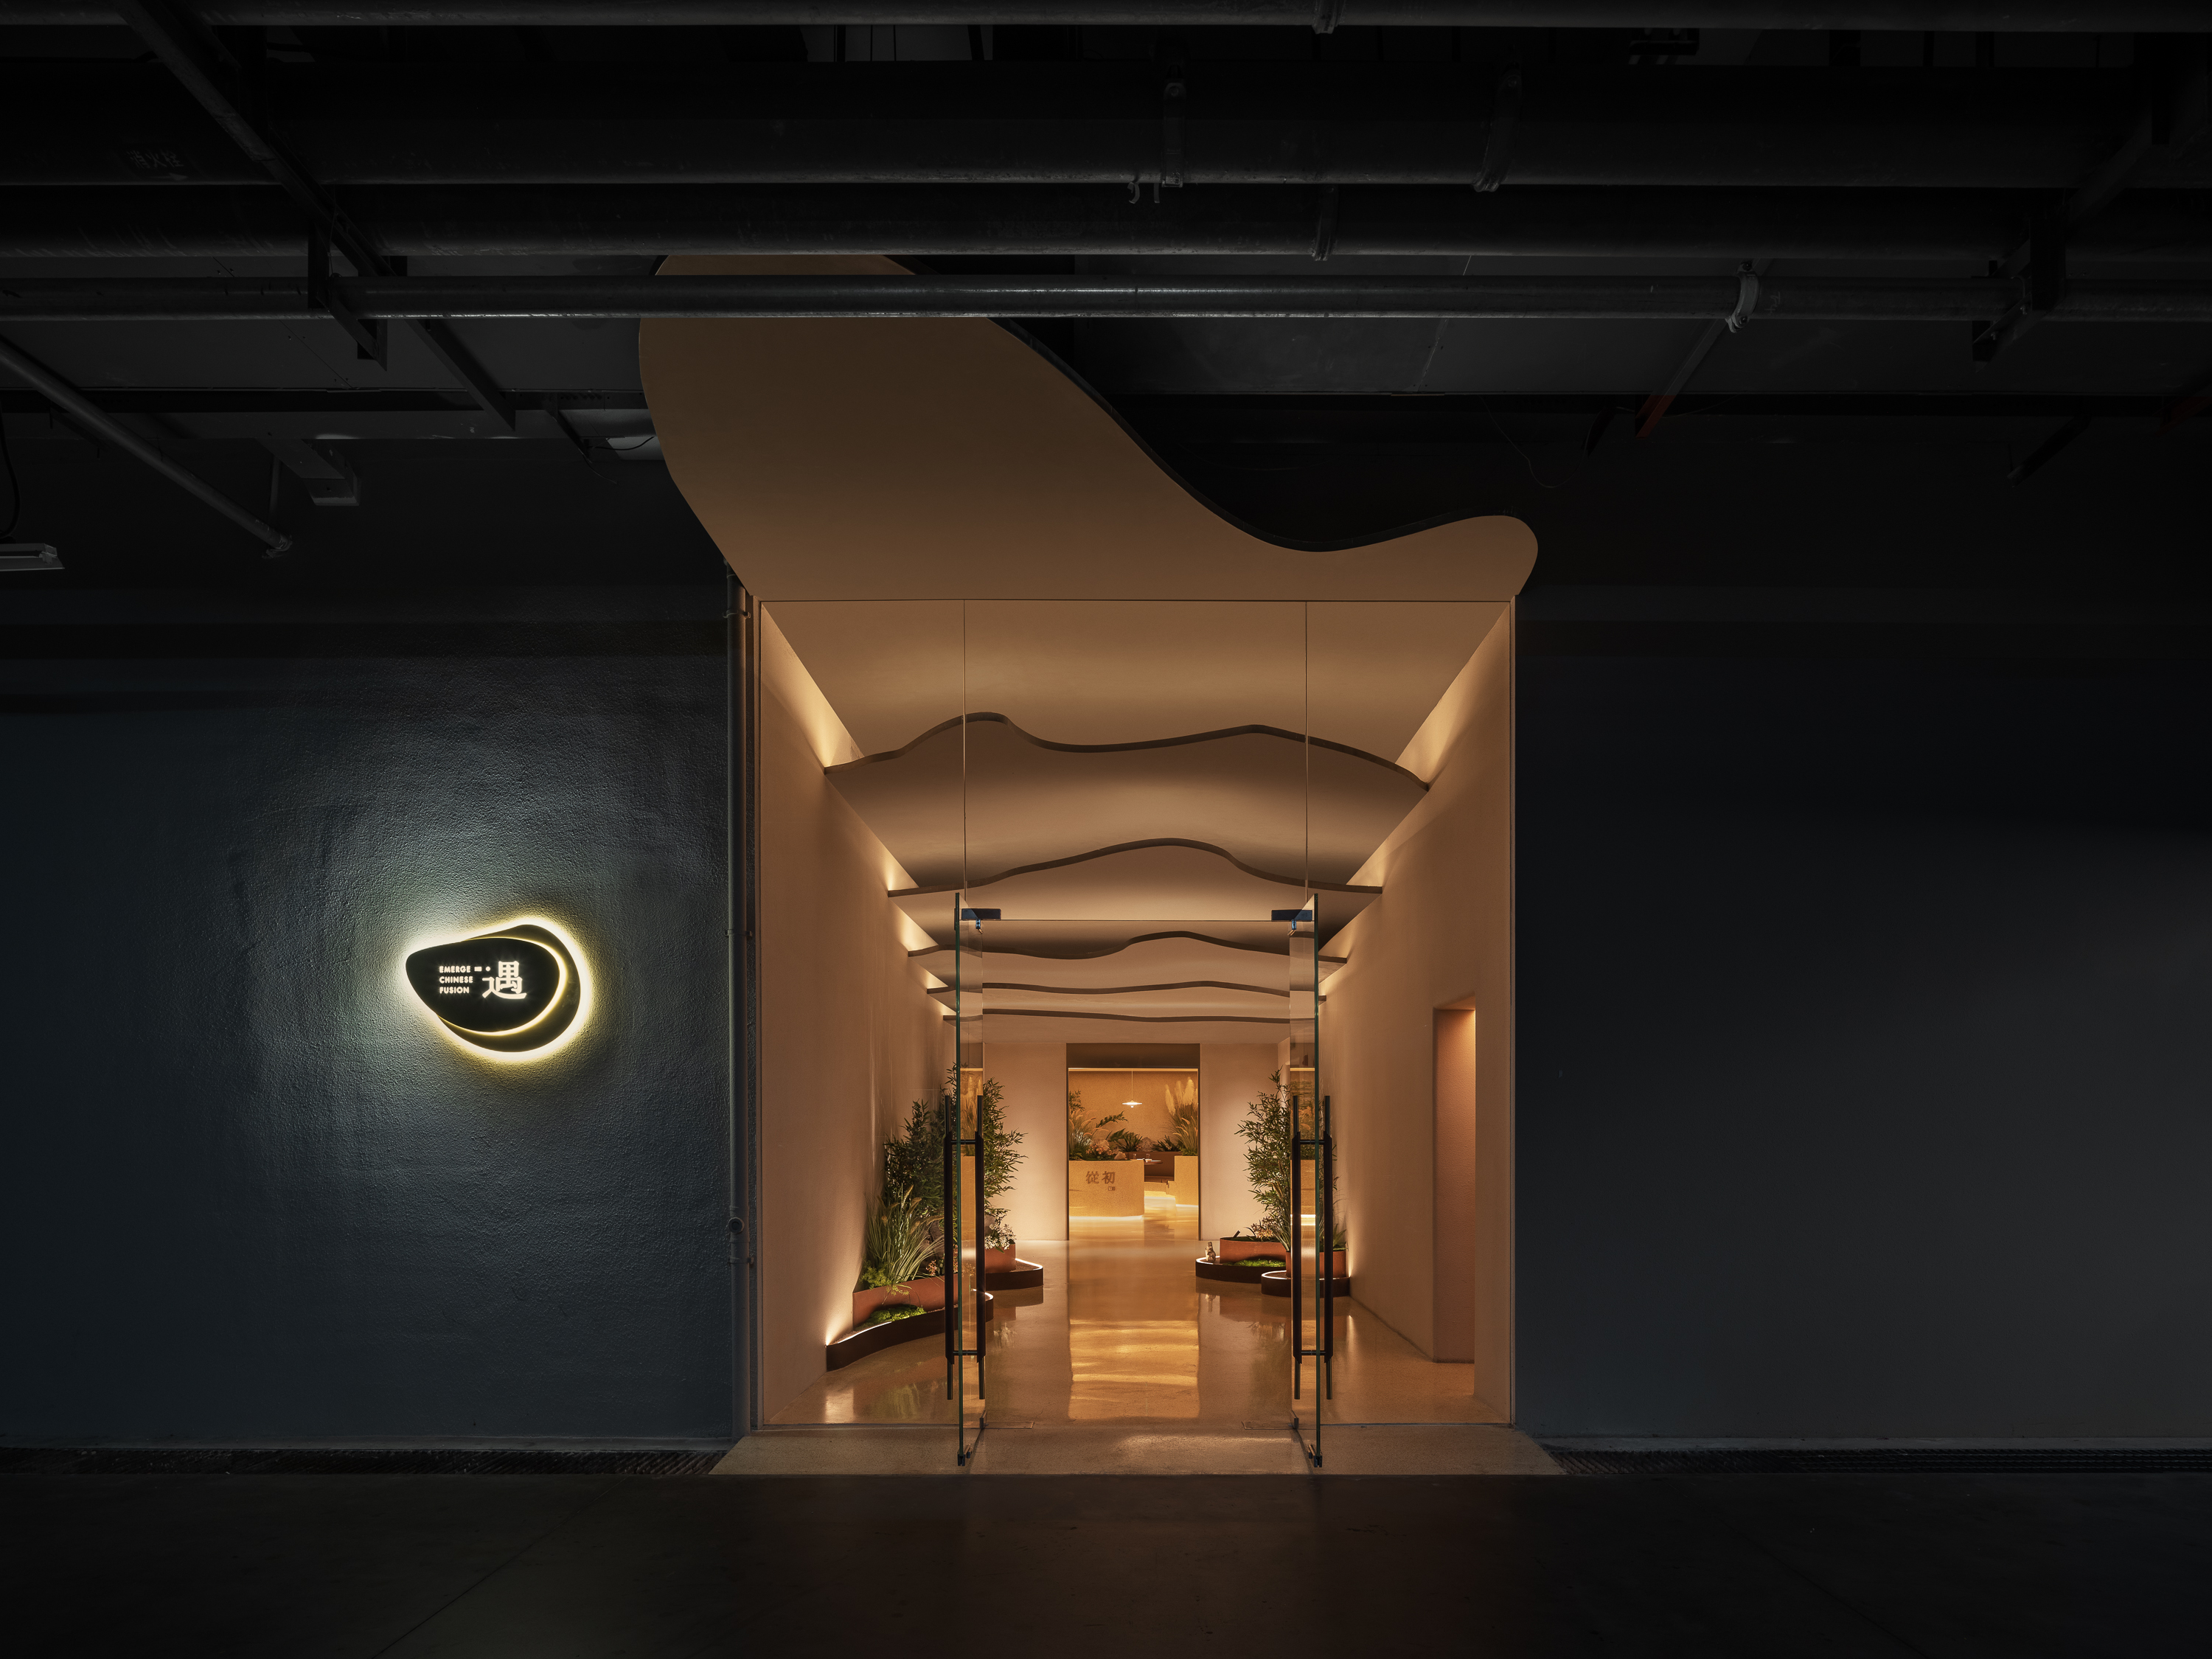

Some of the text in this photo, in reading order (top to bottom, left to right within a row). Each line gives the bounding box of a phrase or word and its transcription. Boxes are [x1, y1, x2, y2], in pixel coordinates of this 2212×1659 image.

[439, 965, 471, 973] EMERGE
[439, 975, 473, 984] CHINESE
[481, 960, 527, 999] 遇
